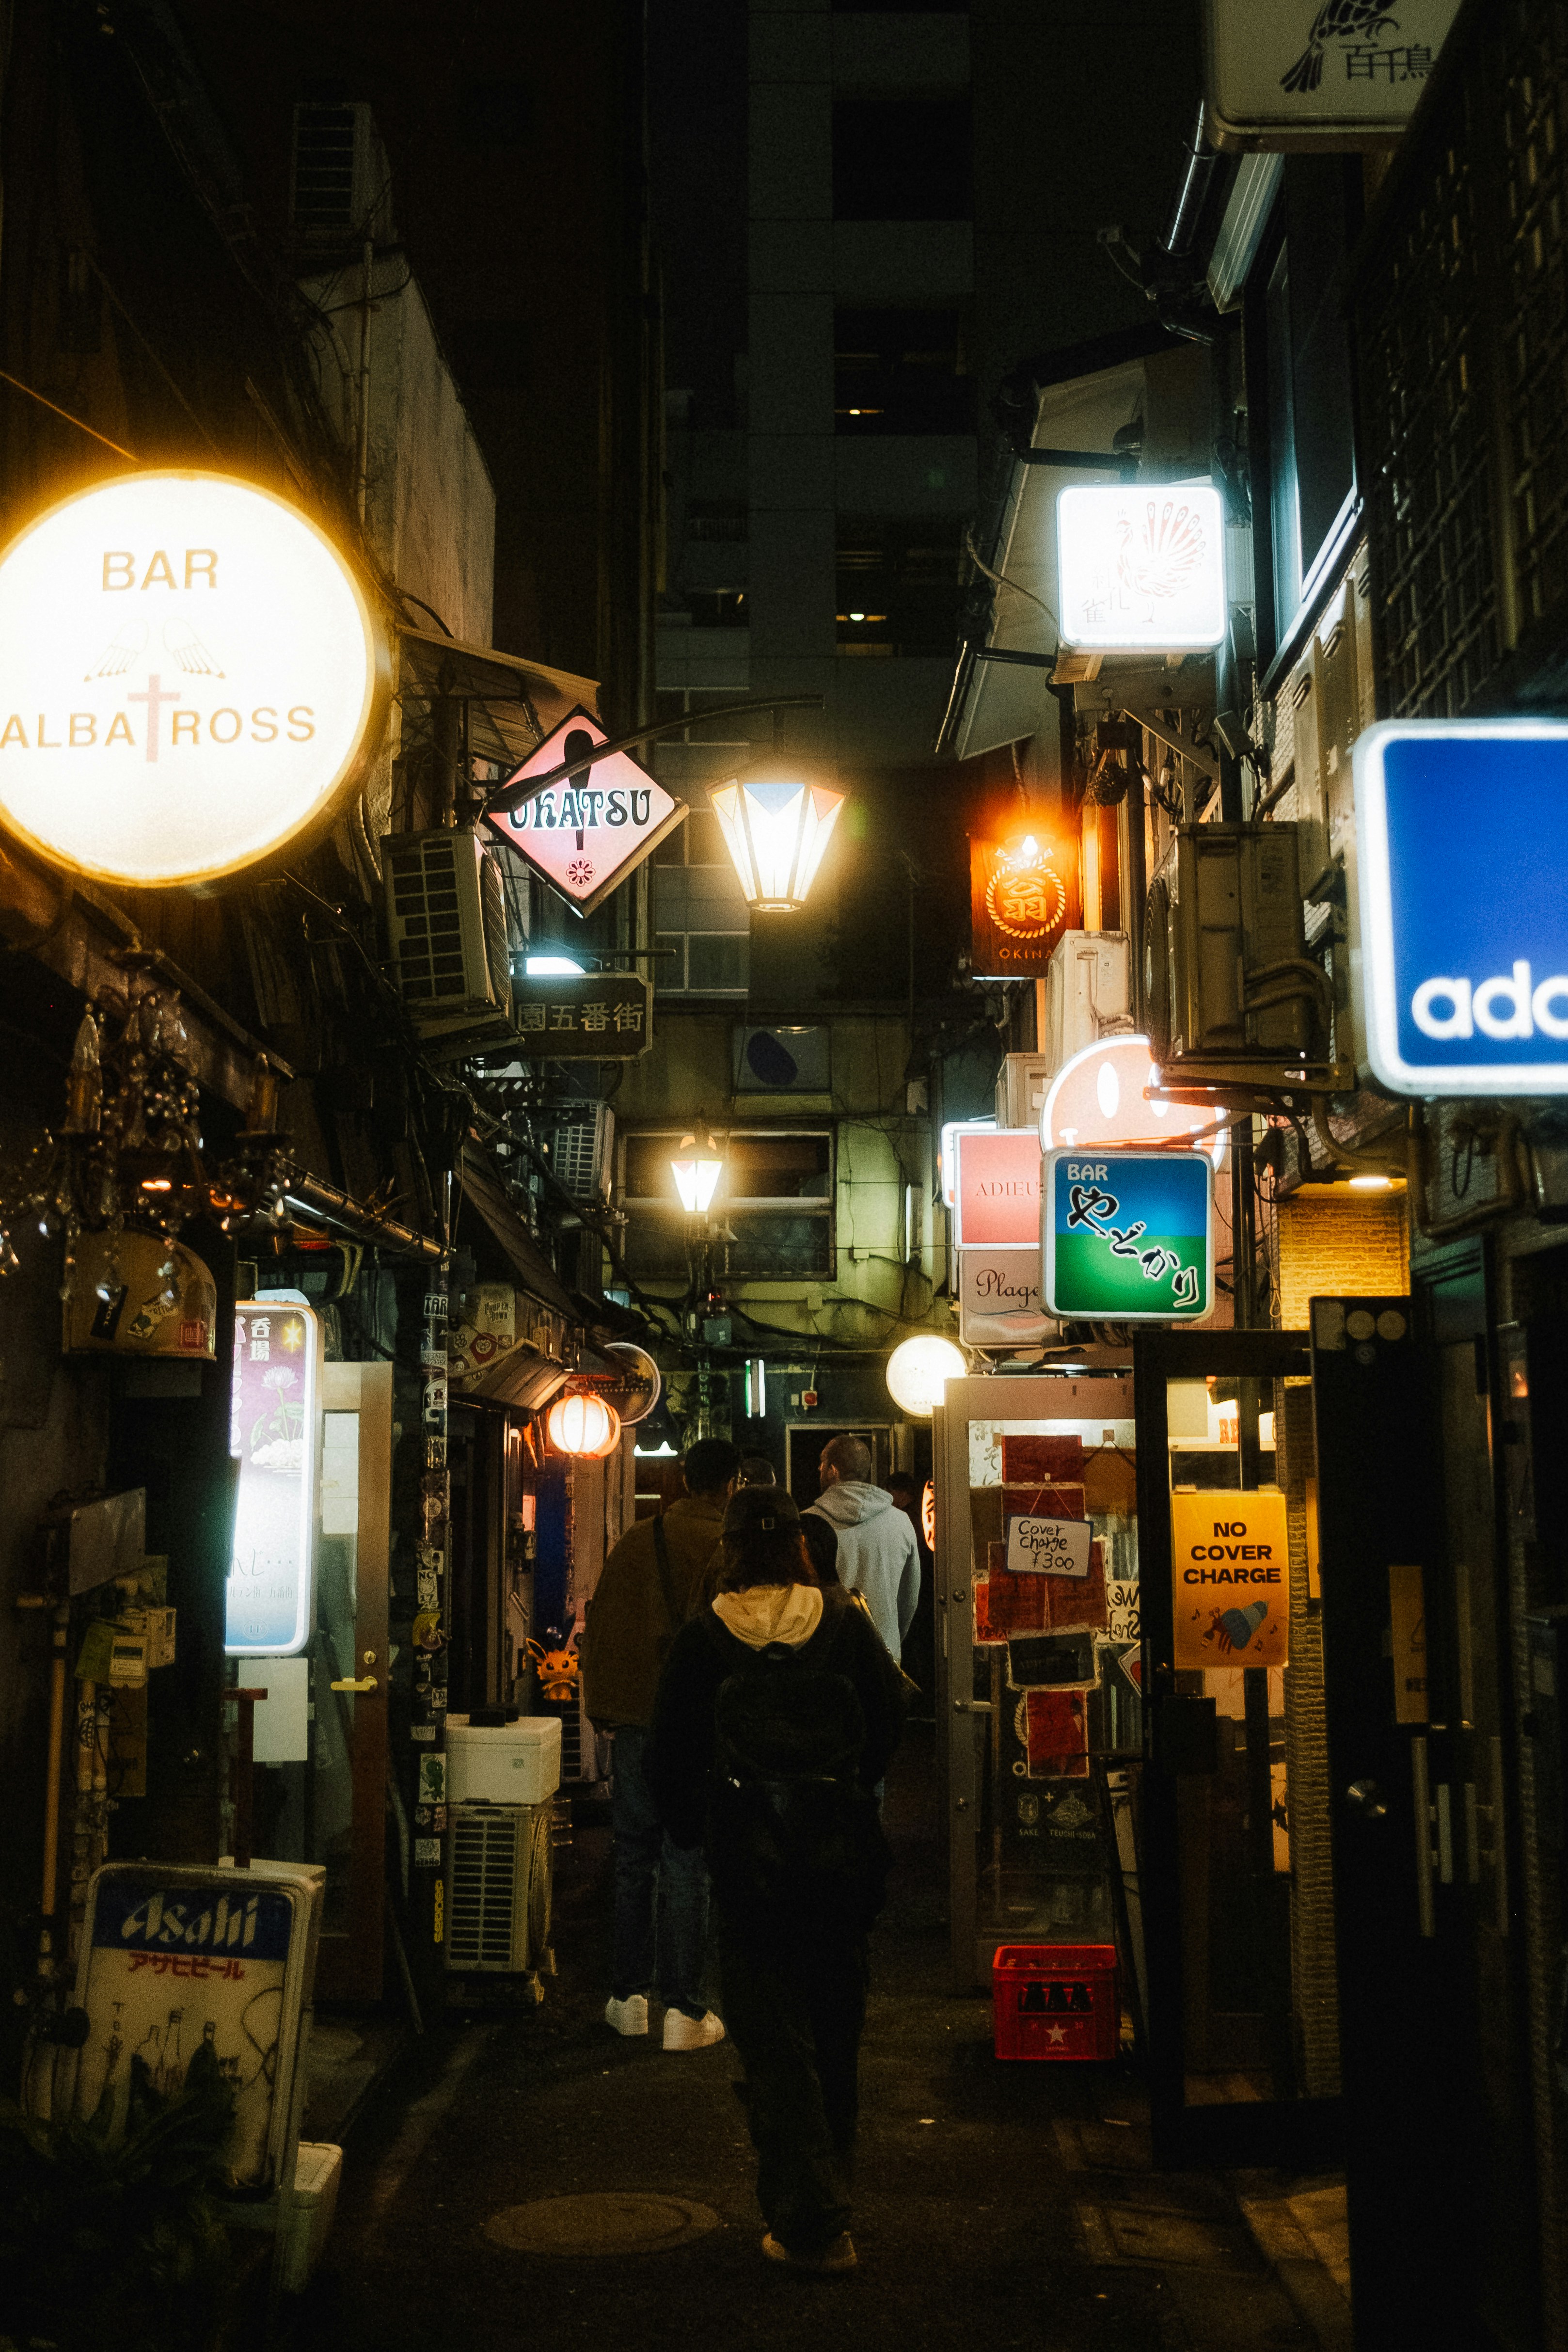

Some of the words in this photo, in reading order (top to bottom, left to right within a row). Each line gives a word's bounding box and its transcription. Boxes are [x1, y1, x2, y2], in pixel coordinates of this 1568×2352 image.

[102, 548, 219, 591] BAR
[0, 674, 316, 762] ALBATROSS
[518, 1002, 643, 1033] 園五番街
[1067, 1163, 1108, 1181] BAR
[975, 1181, 1039, 1197] ADIEU
[1067, 1185, 1197, 1306] やどかり
[1018, 1520, 1066, 1537] Cover
[1214, 1522, 1247, 1538] NO
[1030, 1552, 1075, 1570] ¥300
[1190, 1545, 1272, 1560] COVER
[1183, 1568, 1281, 1584] CHARGE
[1019, 1828, 1039, 1836] SAKE
[121, 1891, 259, 1947] Asahi
[128, 1952, 245, 1981] アサヒビール
